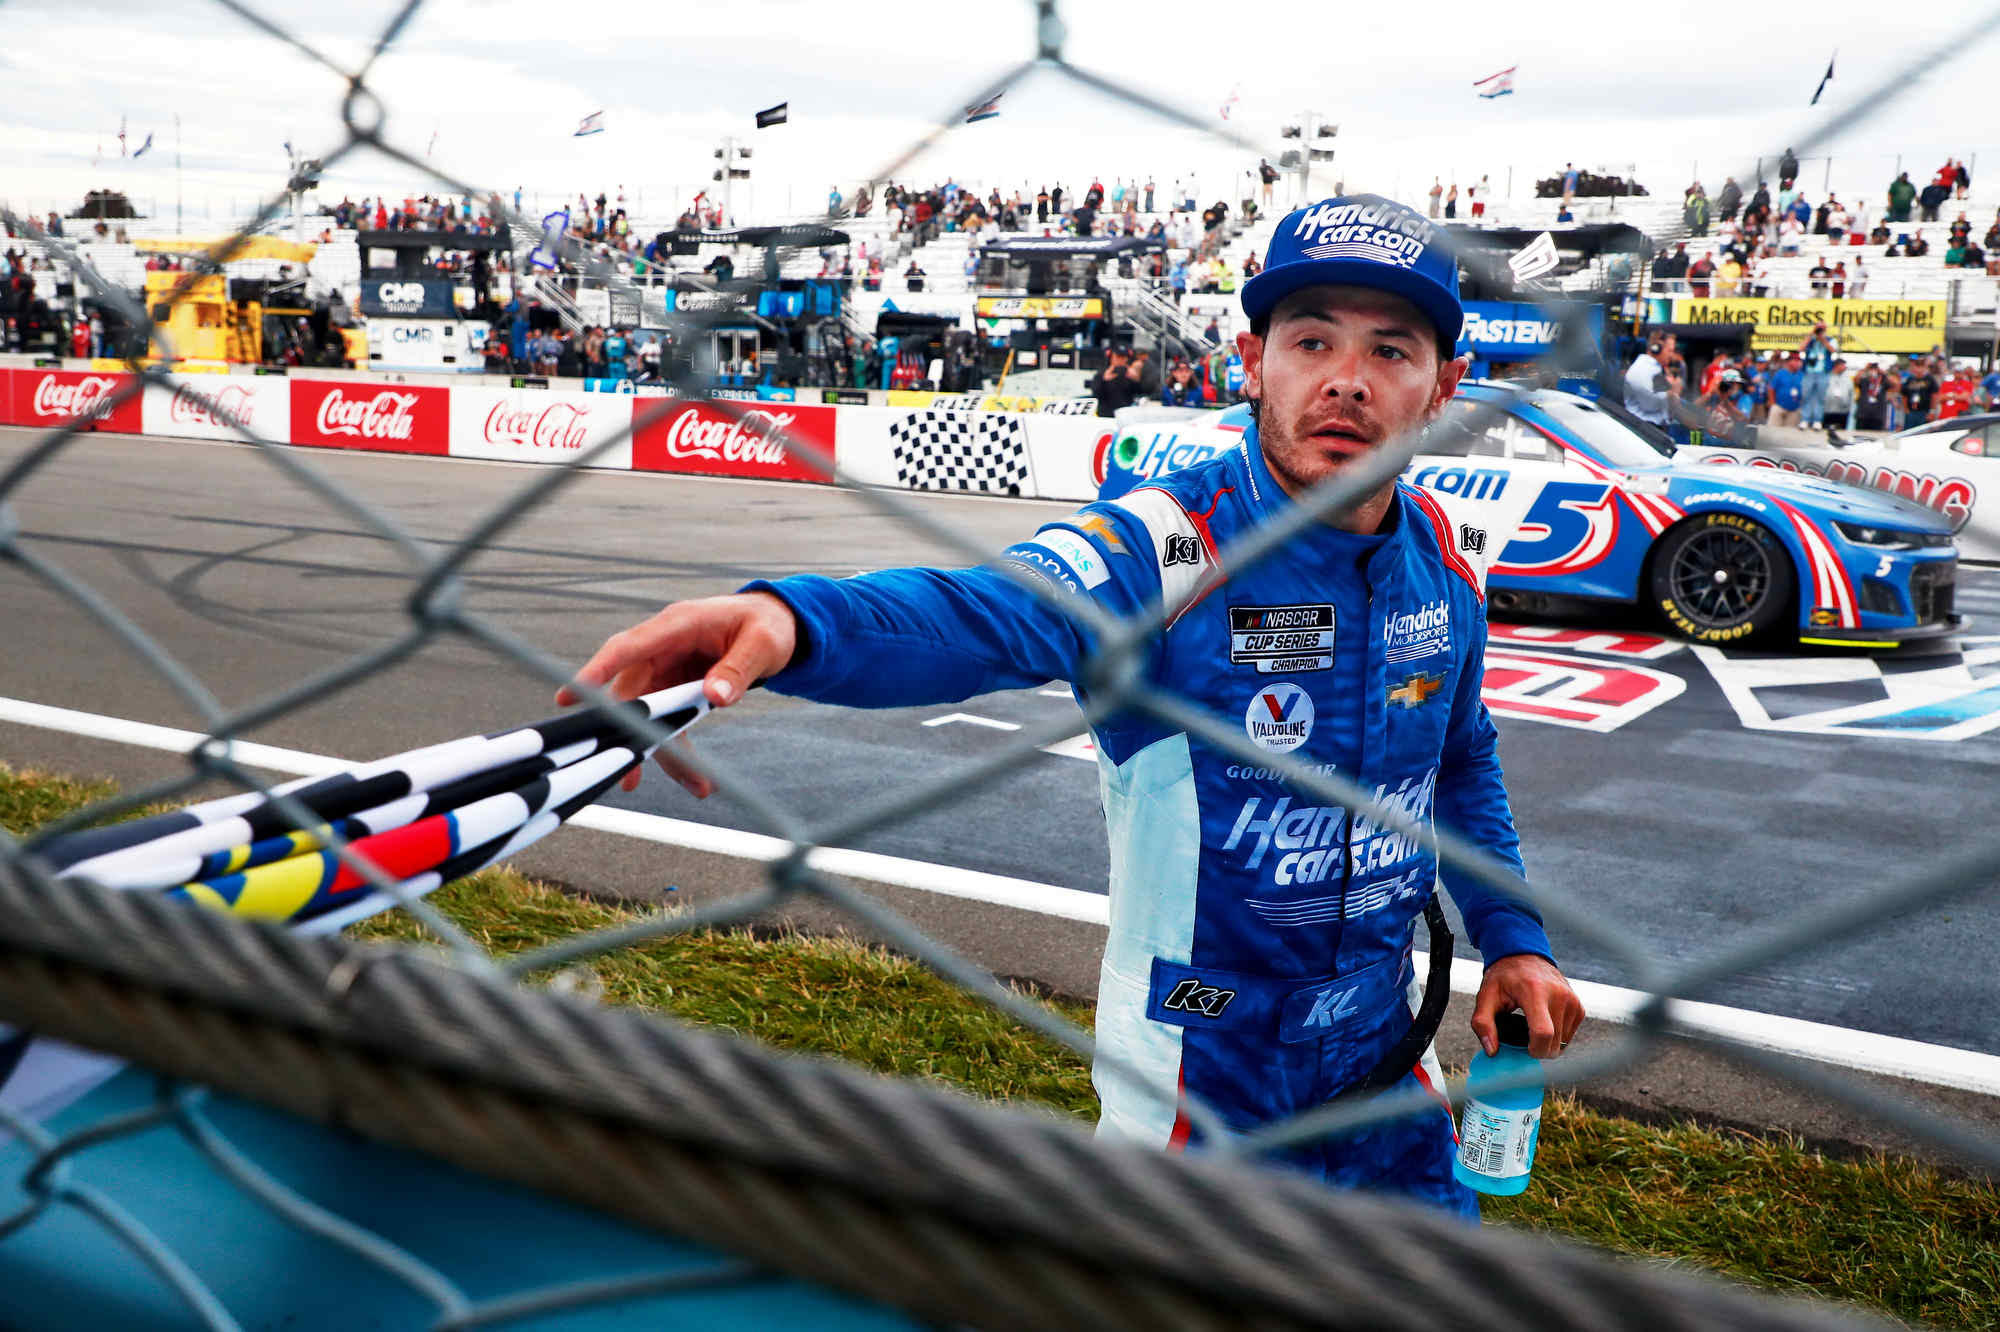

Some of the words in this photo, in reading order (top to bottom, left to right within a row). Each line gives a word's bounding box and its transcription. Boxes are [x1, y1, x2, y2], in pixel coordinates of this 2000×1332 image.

[1294, 204, 1436, 245] Hendrick
[1318, 225, 1424, 260] cars.com
[1456, 312, 1563, 344] FASTENA
[1689, 305, 1759, 325] Makes
[1768, 304, 1825, 327] Glass
[1833, 305, 1935, 328] Invisible!
[34, 374, 117, 421] Coca-Cola
[317, 389, 420, 440] Coca-Cola
[484, 400, 591, 449] Coca-Cola
[667, 409, 796, 464] Coca-Cola
[1460, 523, 1487, 554] K1
[1494, 480, 1612, 568] 5
[1706, 514, 1757, 532] EAGLE
[1163, 533, 1201, 567] K1
[1875, 555, 1895, 577] 5
[1266, 611, 1319, 628] NASCAR
[1384, 600, 1449, 646] Hendrick
[1392, 625, 1449, 647] MOTORSPORTS
[1245, 634, 1275, 650] CUP
[1274, 632, 1321, 649] SERIES
[1271, 657, 1320, 671] CHAMPION
[1252, 720, 1306, 739] VALVOLINE
[1226, 763, 1336, 784] GOODAR
[1222, 767, 1437, 870] Hendrick
[1274, 832, 1419, 886] cars.com
[1162, 979, 1236, 1018] K1
